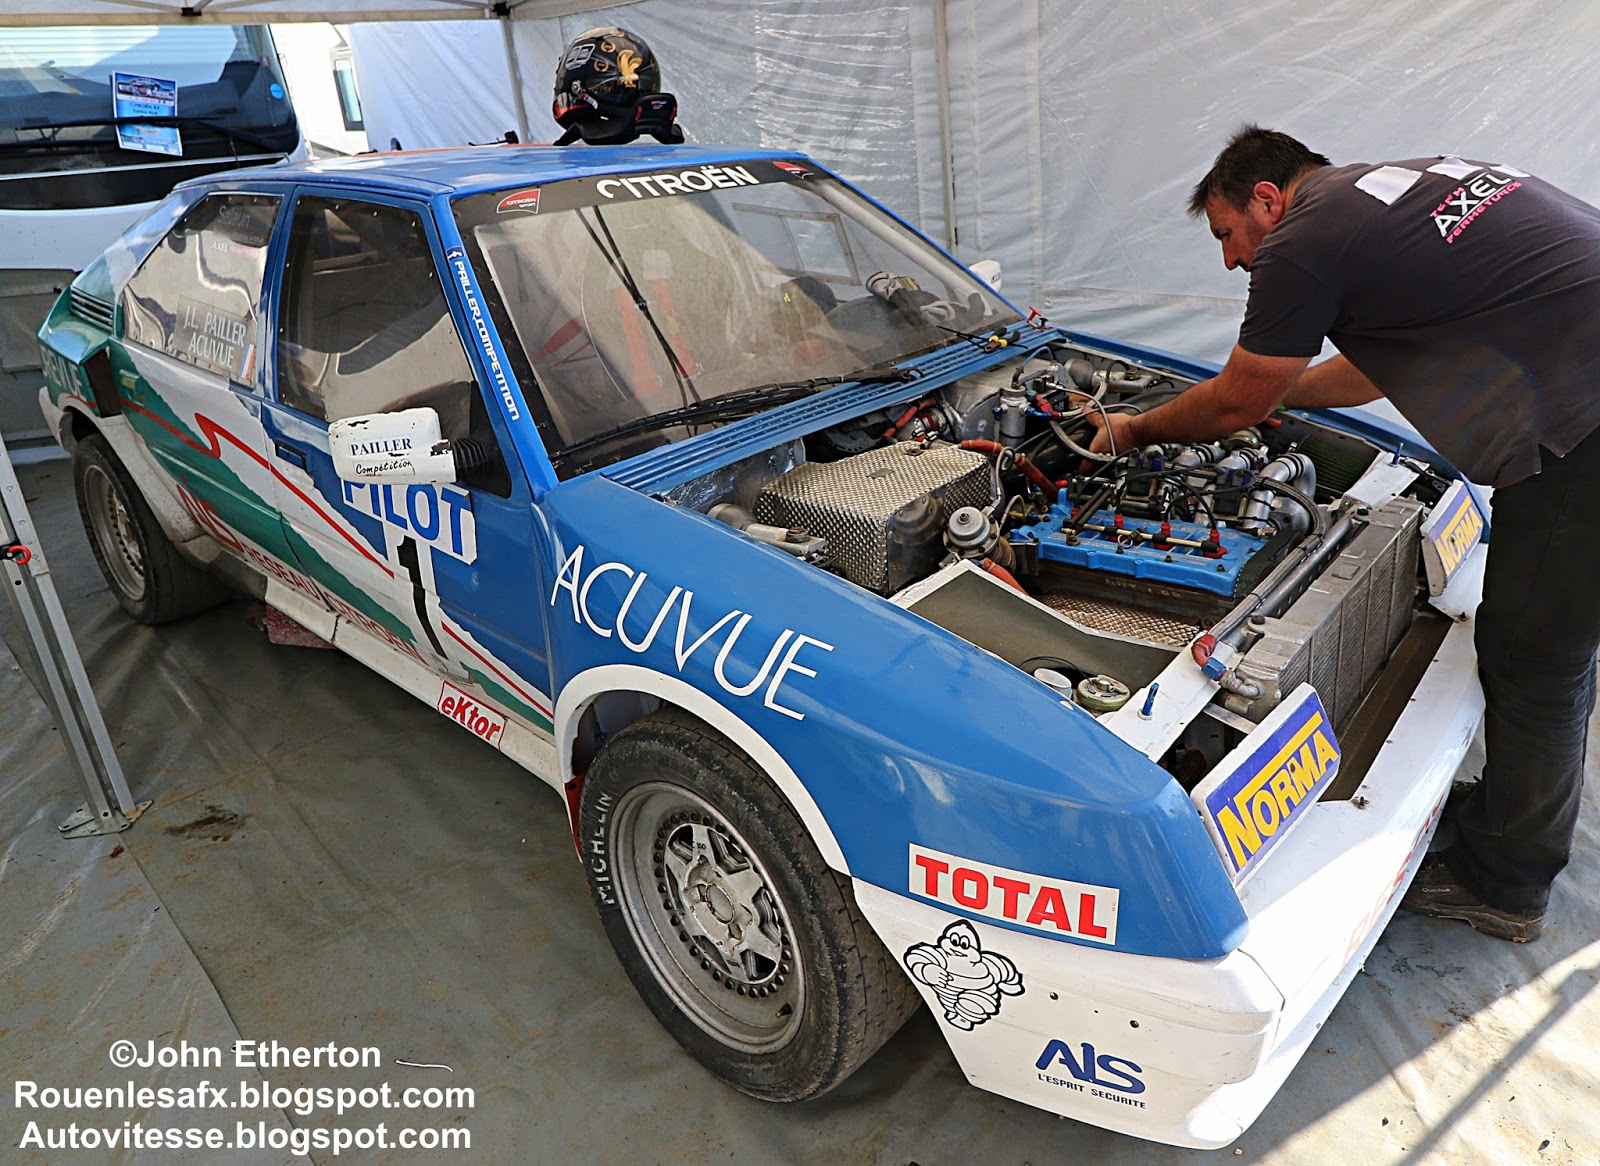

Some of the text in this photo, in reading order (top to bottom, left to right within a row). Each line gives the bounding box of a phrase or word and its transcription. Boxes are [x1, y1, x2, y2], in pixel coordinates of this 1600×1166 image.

[596, 165, 760, 199] CITROËN
[1434, 172, 1512, 238] AXEL
[188, 331, 235, 370] ACUVUE
[204, 311, 247, 348] PAILLER
[350, 437, 413, 457] PAILLER
[355, 458, 413, 476] Compétition
[1435, 495, 1484, 578] NORMA
[551, 544, 835, 721] ACUVUE
[440, 696, 501, 741] eKtor
[1216, 710, 1340, 869] NORMA
[915, 854, 1107, 939] TOTAL
[1035, 1039, 1146, 1095] AIS
[1037, 1073, 1147, 1109] L'ESPRIT SECURITE
